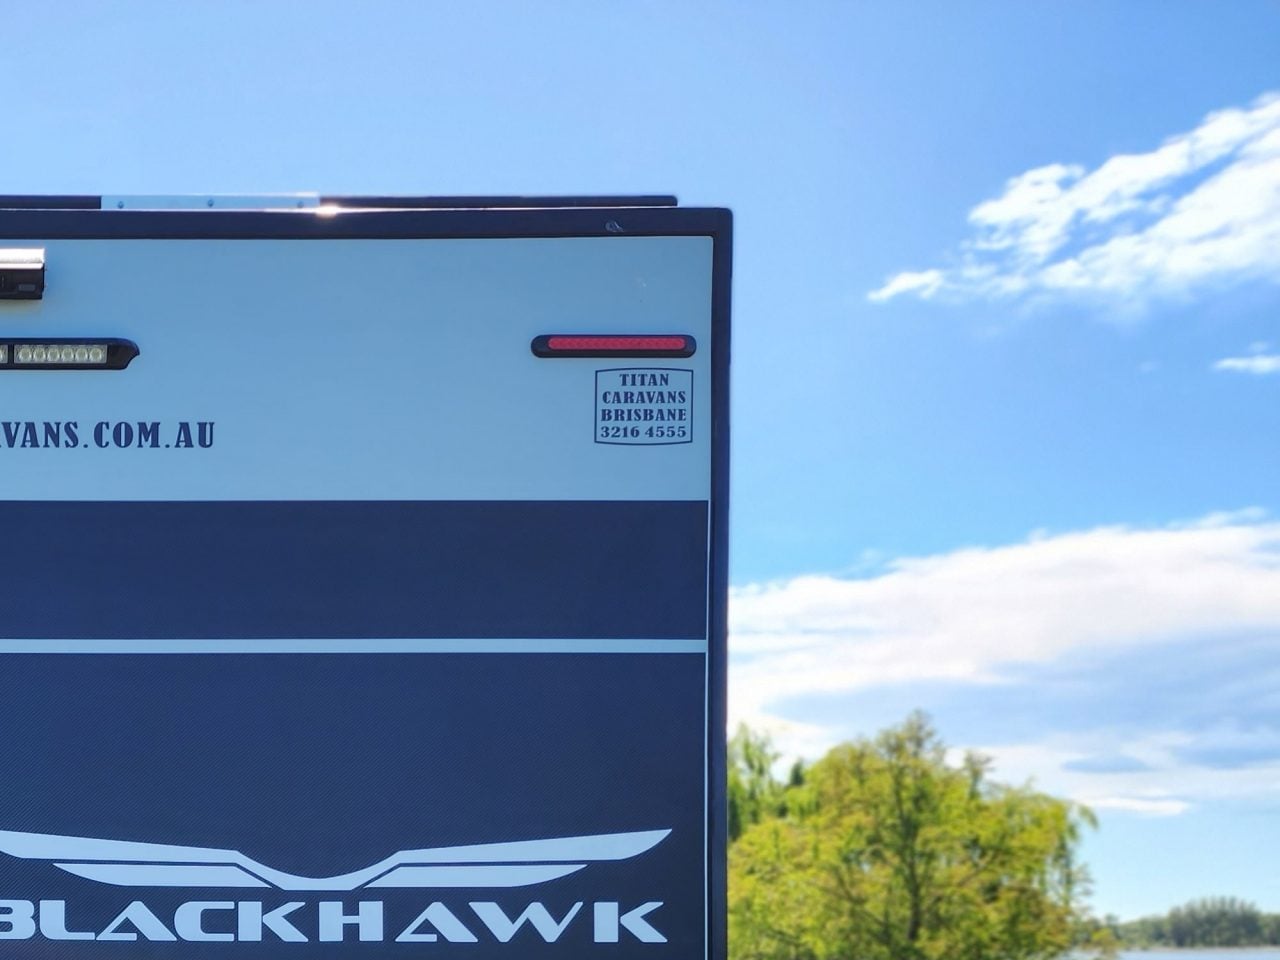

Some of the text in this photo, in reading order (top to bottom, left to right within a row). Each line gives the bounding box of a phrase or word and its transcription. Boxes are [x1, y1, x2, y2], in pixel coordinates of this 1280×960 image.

[619, 373, 669, 386] TITAN
[602, 391, 686, 403] CARAVANS
[601, 408, 687, 421] BRISBANE
[600, 425, 686, 438] 3216 4555
